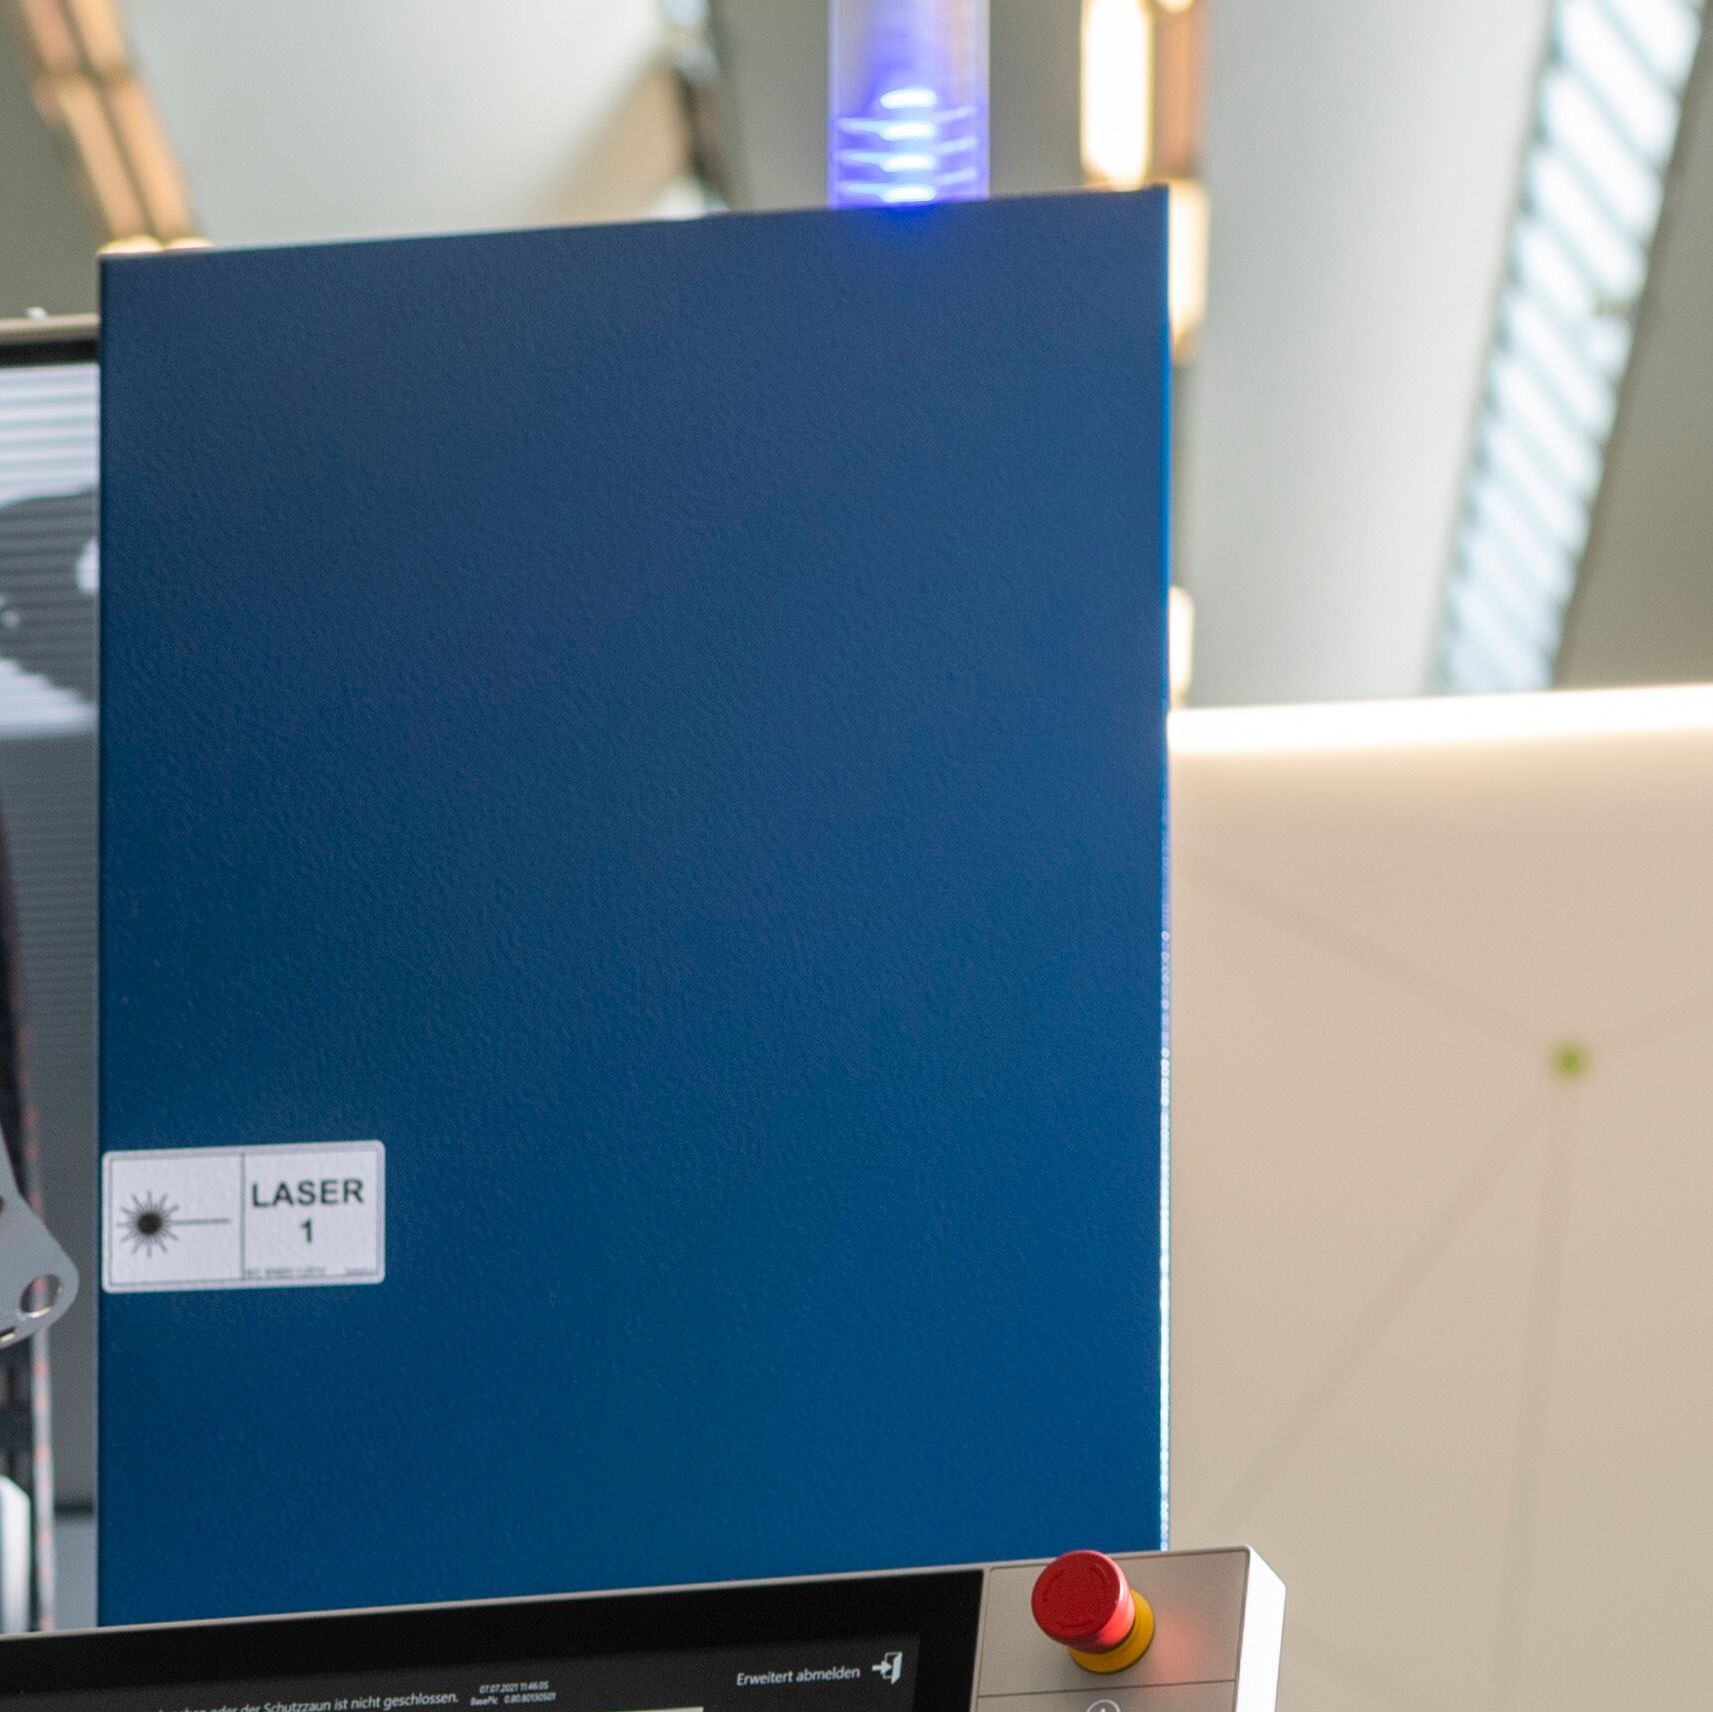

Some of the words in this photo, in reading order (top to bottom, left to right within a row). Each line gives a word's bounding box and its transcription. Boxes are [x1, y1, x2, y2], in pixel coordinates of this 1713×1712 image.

[252, 1178, 364, 1207] LASER
[300, 1218, 313, 1243] 1
[736, 1671, 793, 1686] Erweitert
[796, 1666, 860, 1683] abmelden
[335, 1697, 349, 1711] ist
[351, 1695, 382, 1710] nicht
[384, 1691, 459, 1711] geschlossen.
